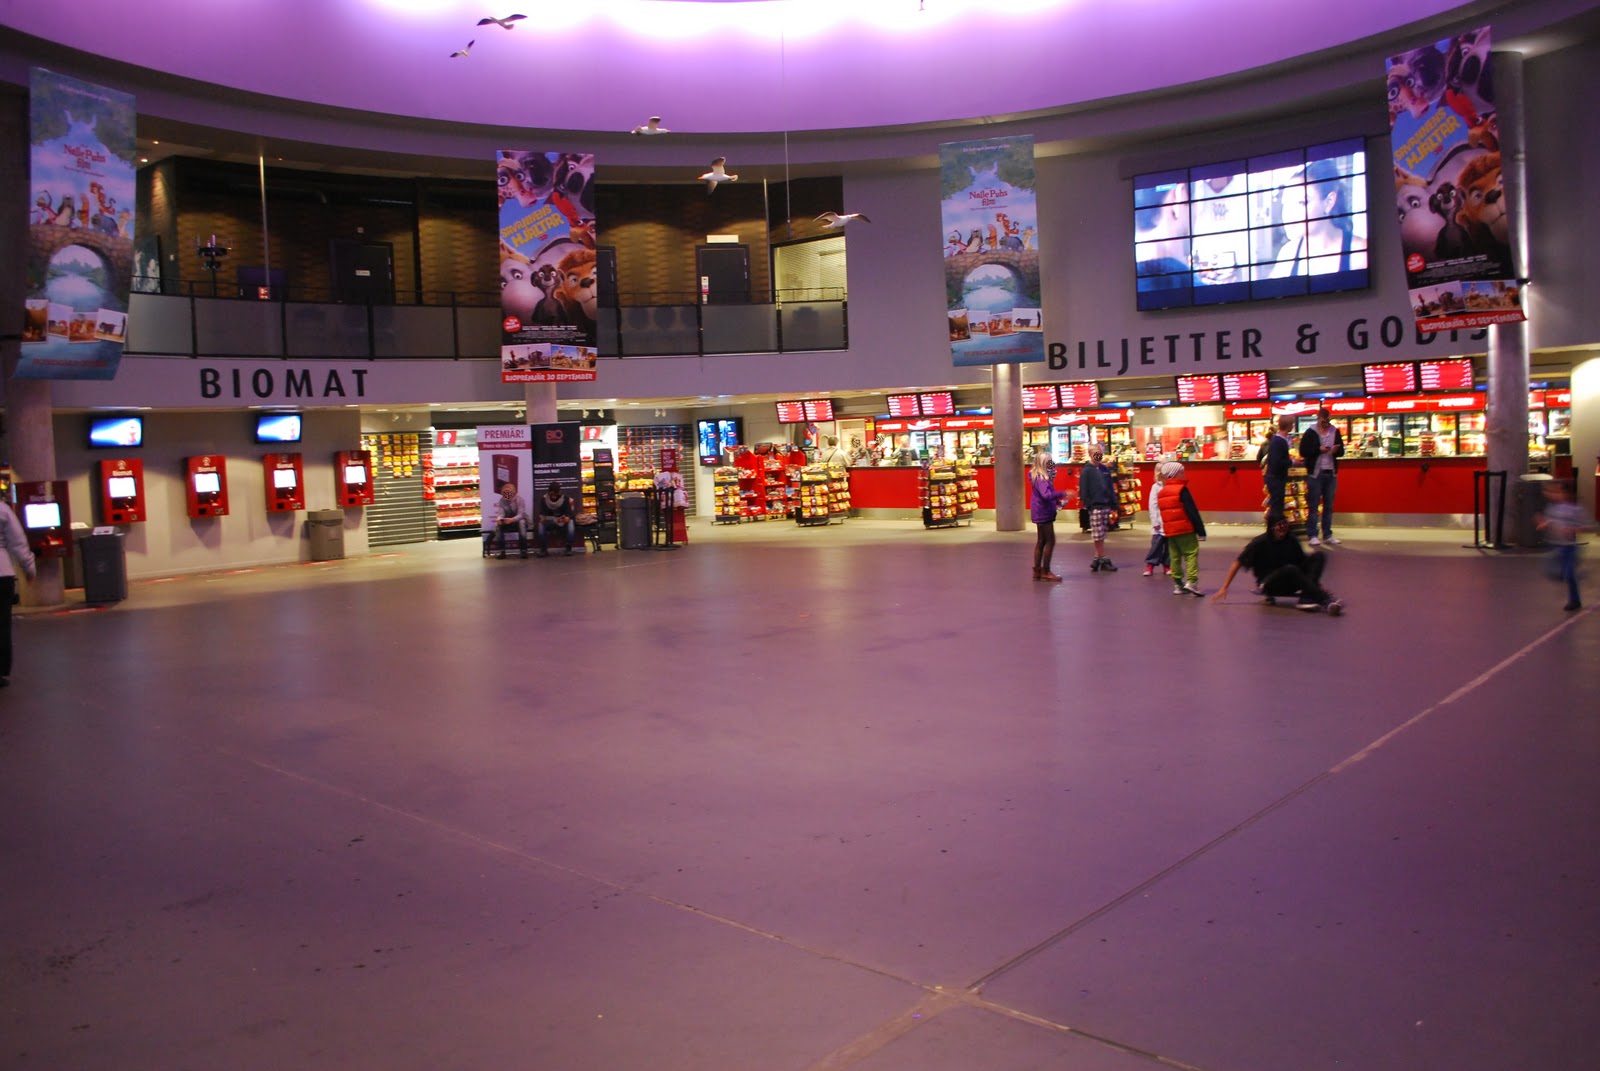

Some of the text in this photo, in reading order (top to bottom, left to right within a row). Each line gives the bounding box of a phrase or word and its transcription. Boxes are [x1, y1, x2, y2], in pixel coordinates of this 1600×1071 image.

[969, 189, 1008, 199] Nalle Puhs
[982, 198, 996, 206] film
[1048, 328, 1263, 376] BILJETTER
[1296, 323, 1320, 354] &
[556, 373, 593, 381] SEPTEMBER
[200, 368, 368, 399] BIOMAT
[484, 427, 524, 439] PREMIÄR!
